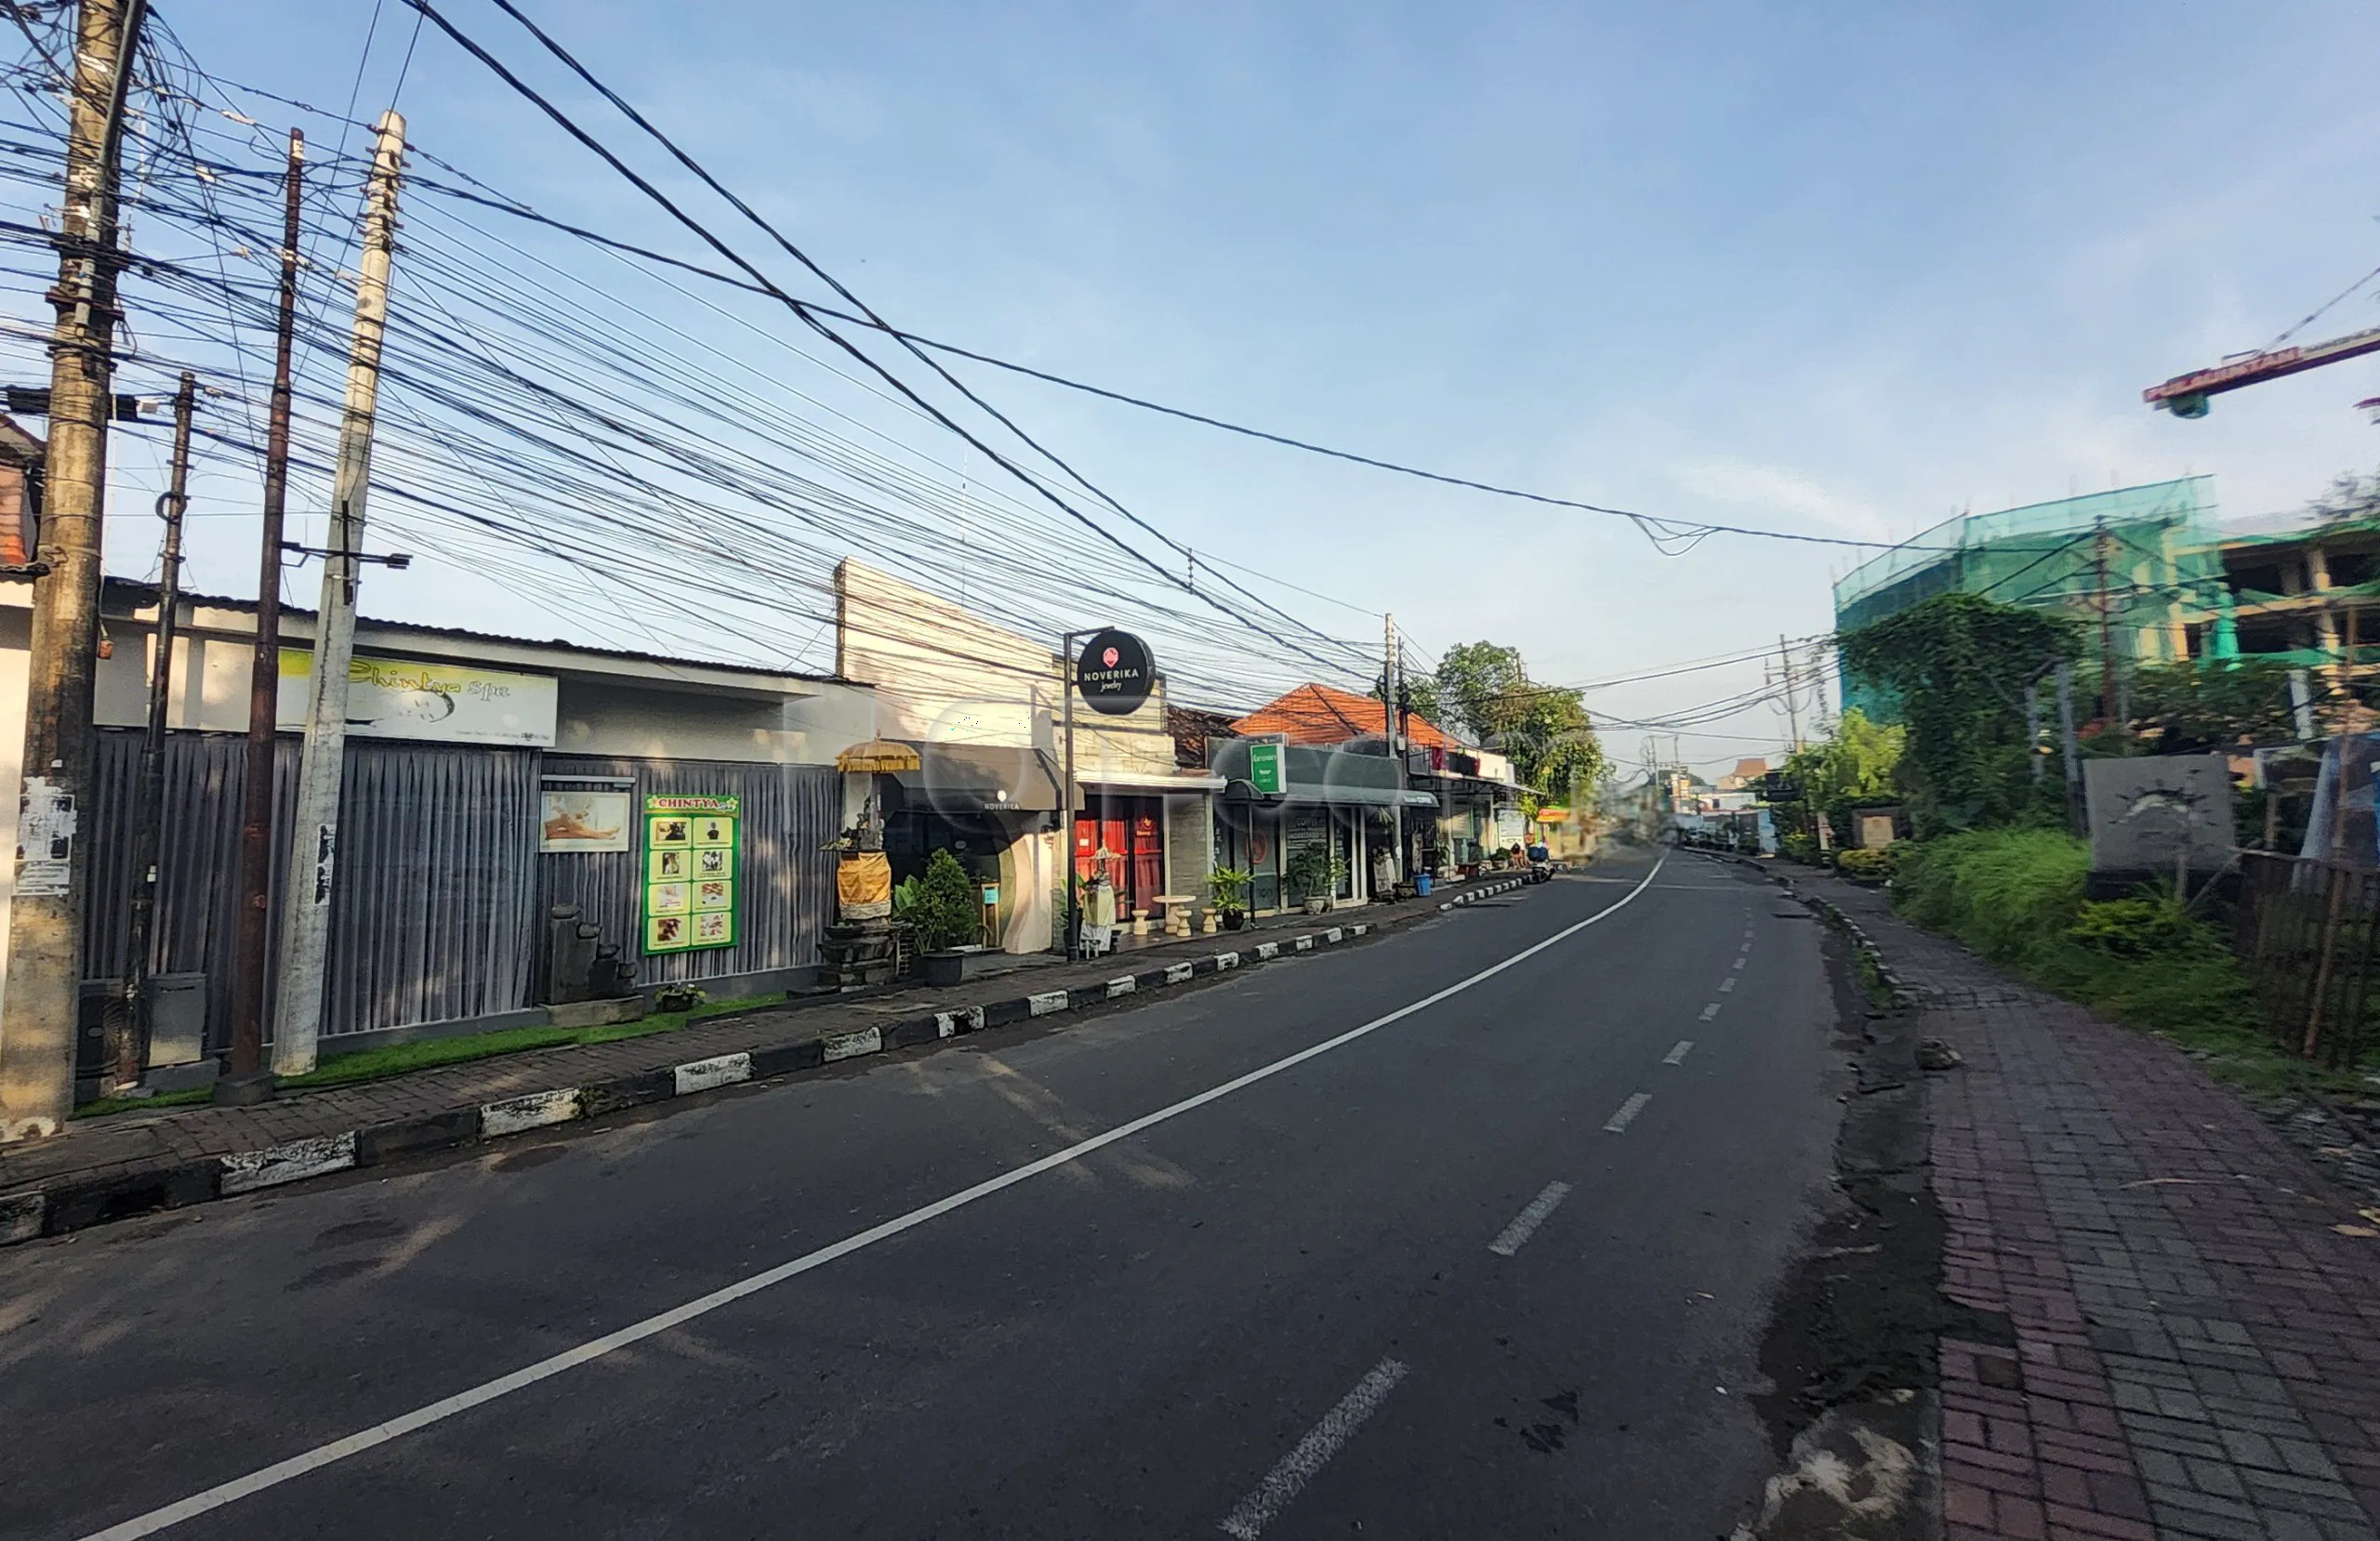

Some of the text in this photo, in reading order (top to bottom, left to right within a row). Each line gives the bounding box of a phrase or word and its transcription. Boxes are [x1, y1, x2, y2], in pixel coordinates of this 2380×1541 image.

[1084, 668, 1139, 681] NOVERIKA
[1100, 680, 1122, 692] jewelry
[658, 798, 719, 808] CHINTYA
